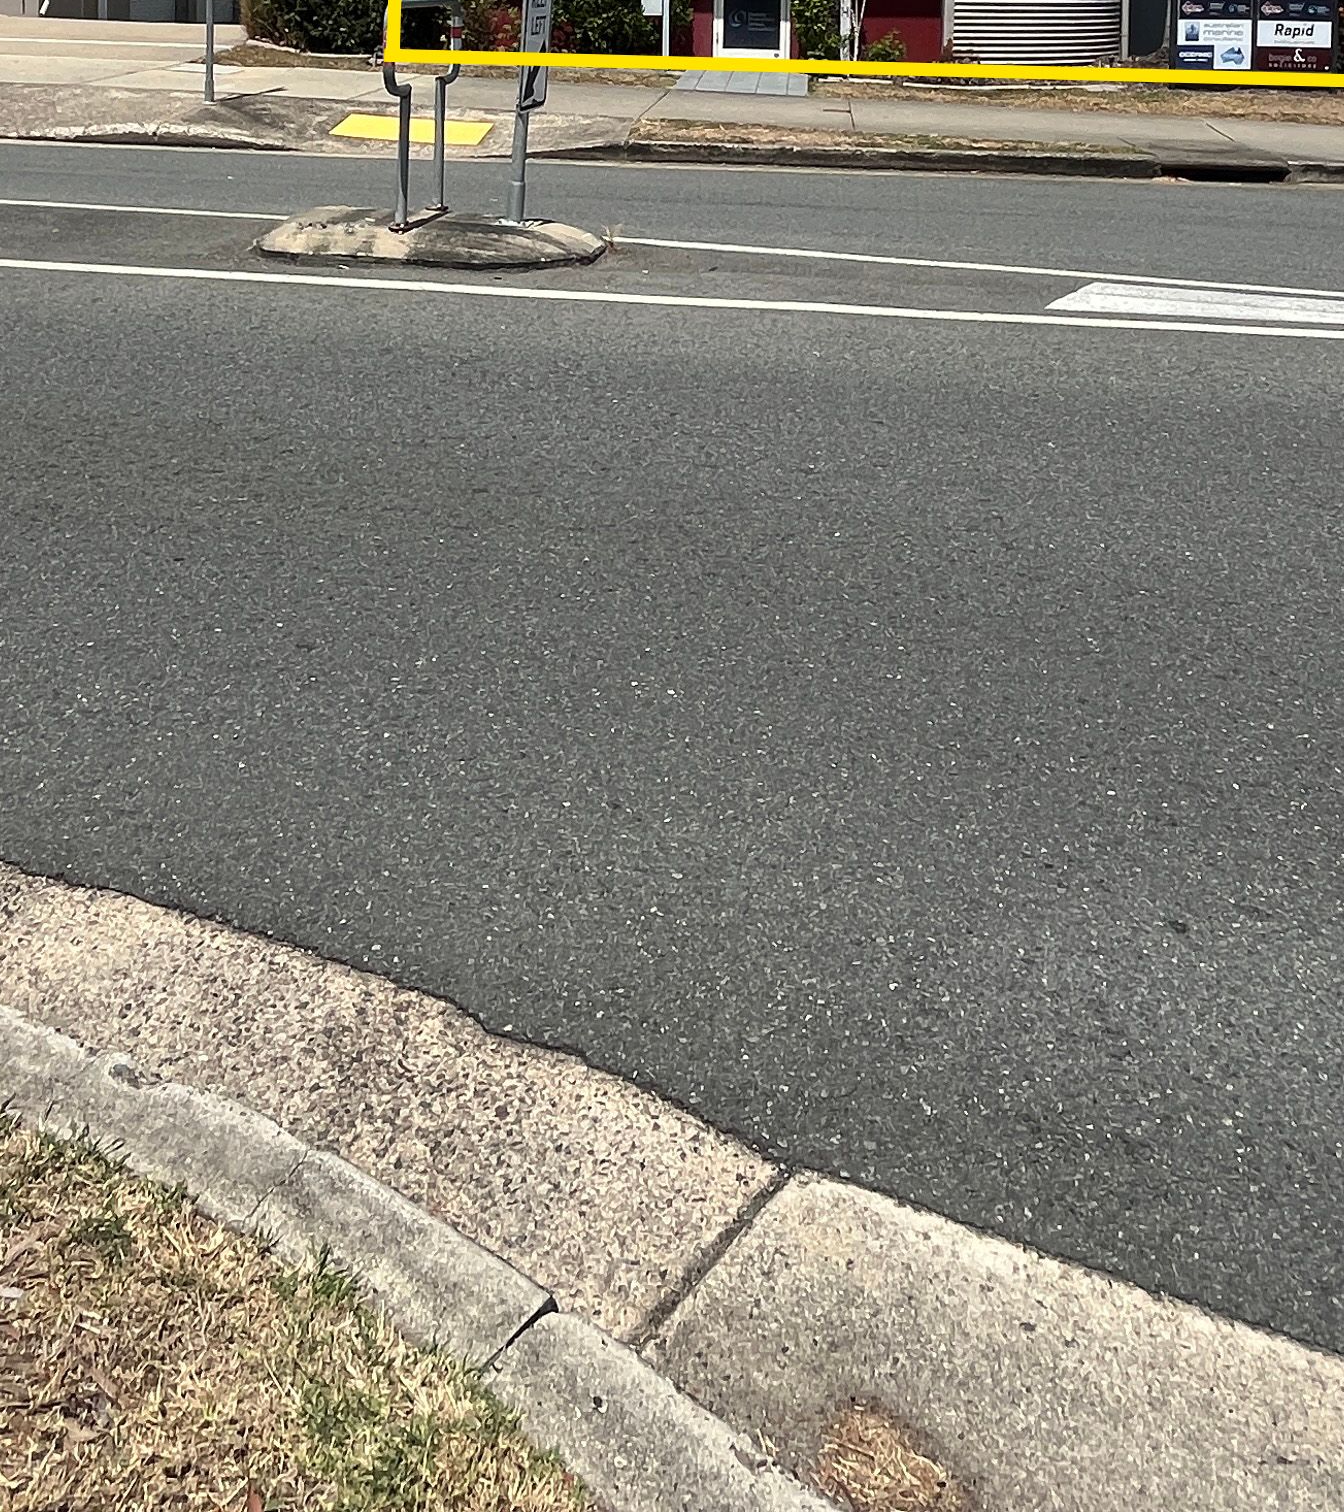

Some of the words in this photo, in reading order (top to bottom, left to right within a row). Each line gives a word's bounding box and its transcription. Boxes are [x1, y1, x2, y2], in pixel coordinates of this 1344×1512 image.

[531, 15, 547, 35] LEFT
[1274, 23, 1315, 39] Rapid
[1293, 48, 1306, 62] &
